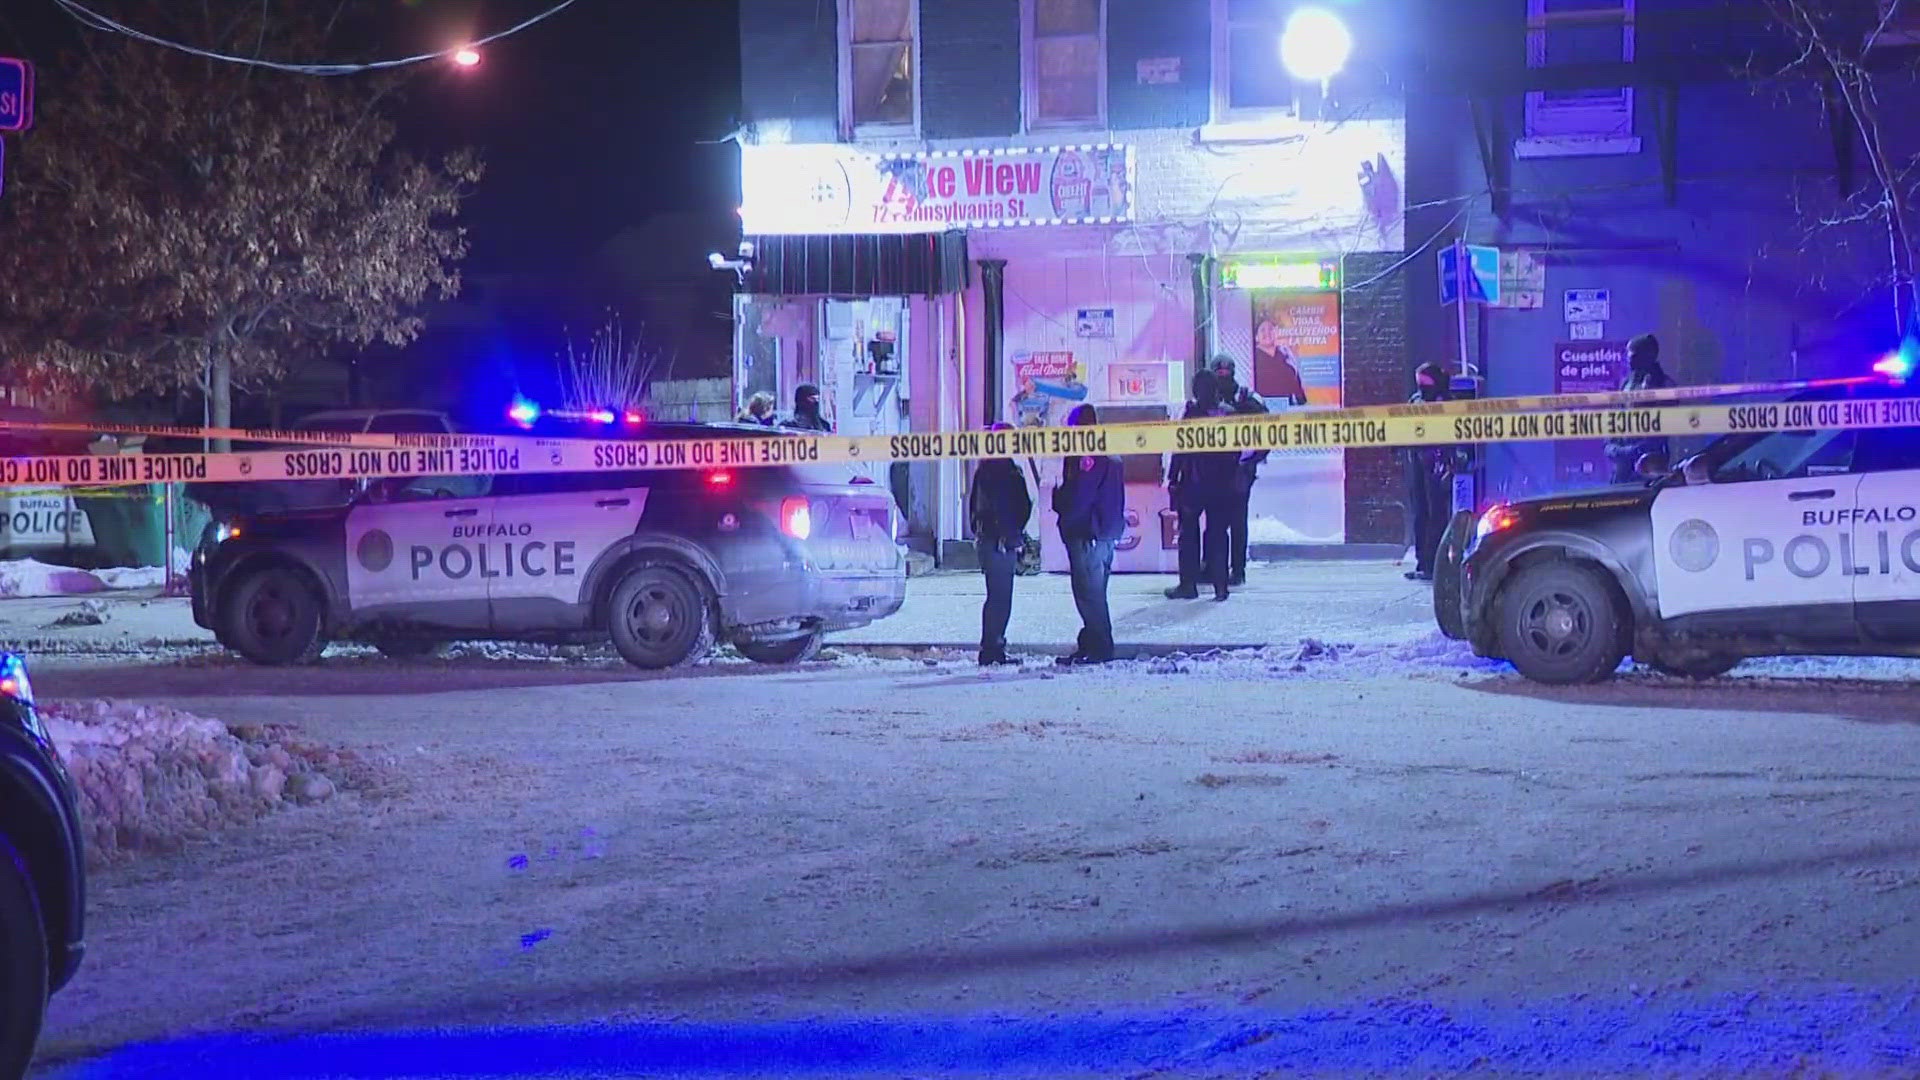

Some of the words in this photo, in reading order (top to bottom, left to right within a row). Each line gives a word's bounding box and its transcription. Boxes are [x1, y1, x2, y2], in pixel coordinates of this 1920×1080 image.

[964, 157, 1041, 197] View
[1008, 200, 1029, 219] St.
[1561, 348, 1622, 362] Cuestión
[1561, 364, 1577, 376] de
[1581, 364, 1610, 379] piel.
[1544, 414, 1564, 435] DO
[1570, 413, 1602, 435] LINE
[1608, 410, 1661, 434] POLICE
[1728, 406, 1778, 429] CROSS
[1784, 405, 1813, 427] NOT
[1818, 404, 1838, 425] DO
[1844, 402, 1876, 425] LINE
[1233, 425, 1262, 447] NOT
[1268, 424, 1288, 445] DO
[1294, 423, 1326, 445] LINE
[1333, 421, 1386, 443] POLICE
[1455, 416, 1503, 439] CROSS
[1510, 415, 1539, 437] NOT
[891, 435, 942, 458] CROSS
[949, 434, 979, 456] NOT
[985, 433, 1006, 454] DO
[1012, 432, 1045, 454] LINE
[1052, 430, 1106, 452] POLICE
[1177, 426, 1227, 449] CROSS
[459, 448, 519, 470] POLICE
[594, 444, 648, 466] CROSS
[655, 443, 686, 465] NOT
[692, 442, 713, 463] DO
[720, 440, 755, 462] LINE
[761, 438, 818, 461] POLICE
[24, 459, 60, 482] NOT
[67, 458, 91, 481] DO
[99, 457, 137, 480] LINE
[144, 456, 206, 479] POLICE
[285, 453, 342, 476] CROSS
[349, 452, 382, 474] NOT
[388, 451, 410, 473] DO
[418, 450, 453, 472] LINE
[20, 500, 61, 510] BUFFALO
[1802, 507, 1916, 526] BUFFALO
[452, 523, 532, 538] BUFFALO
[411, 541, 575, 580] POLICE
